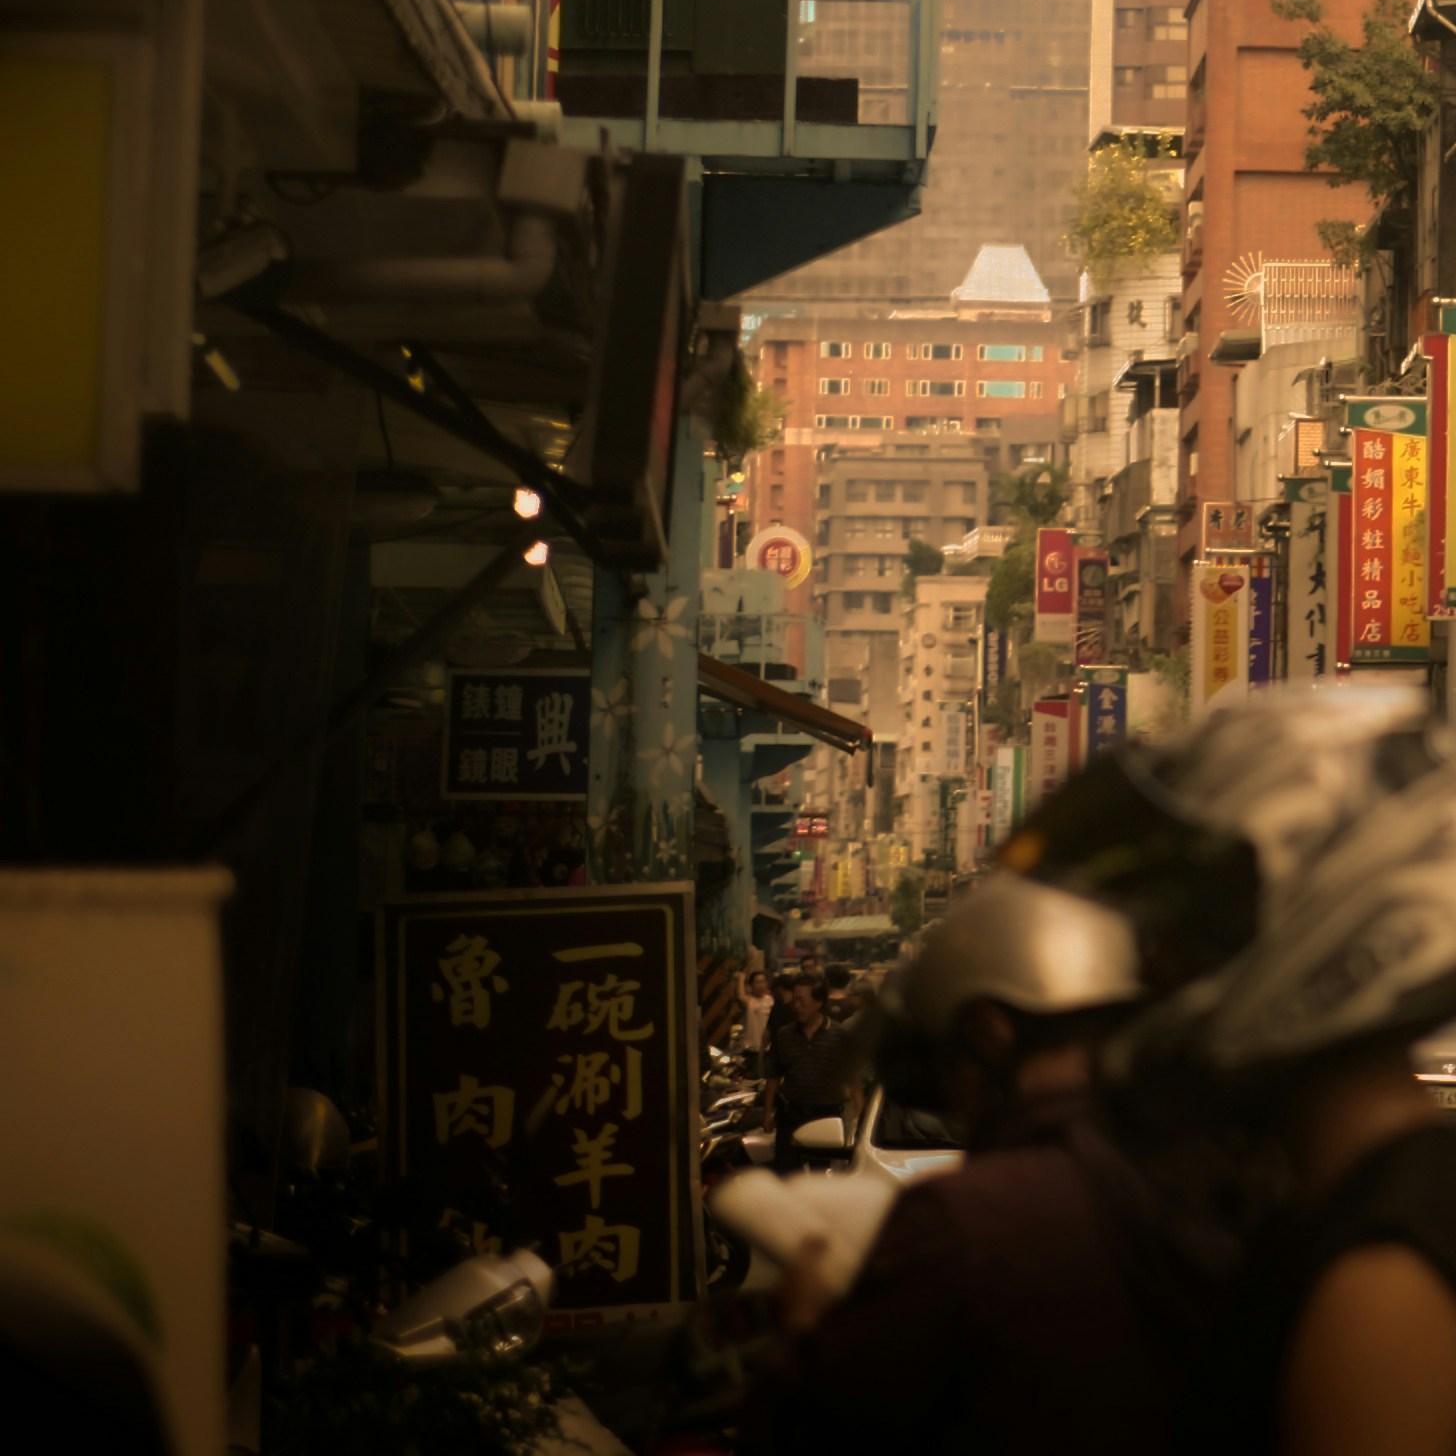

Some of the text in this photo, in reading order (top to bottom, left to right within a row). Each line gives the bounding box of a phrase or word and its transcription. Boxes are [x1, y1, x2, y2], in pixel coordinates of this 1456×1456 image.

[1043, 577, 1069, 593] LG
[545, 941, 655, 1284] 一碗涮羊肉
